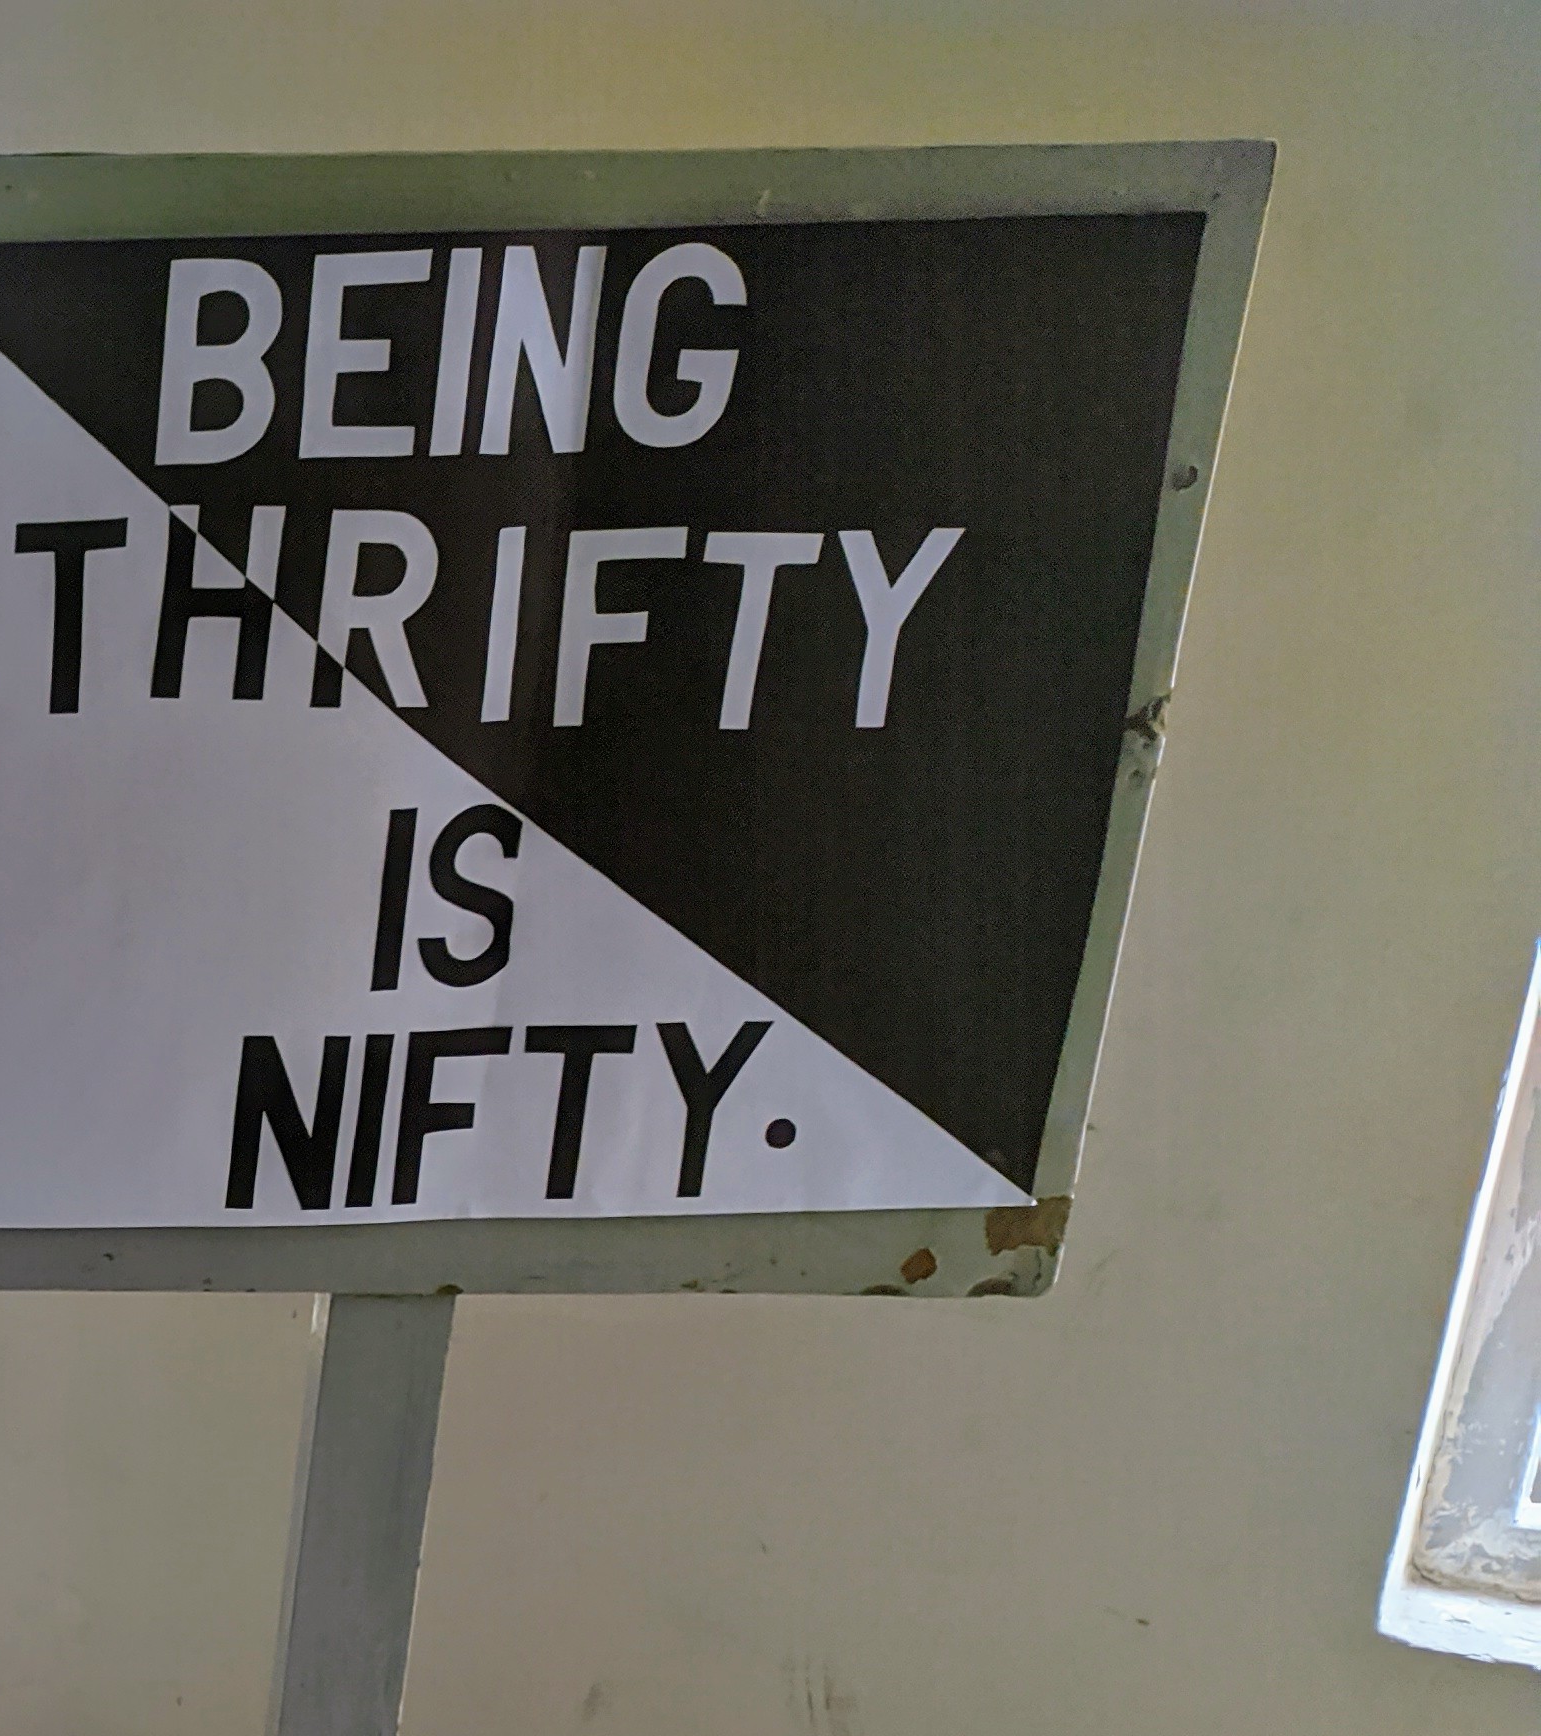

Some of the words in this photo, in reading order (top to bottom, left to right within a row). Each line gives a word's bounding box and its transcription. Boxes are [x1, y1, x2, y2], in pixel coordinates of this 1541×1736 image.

[154, 241, 748, 467] BEING
[13, 505, 966, 730] THRIFTY
[370, 803, 523, 992] IS
[225, 1021, 797, 1211] NIFTY.
